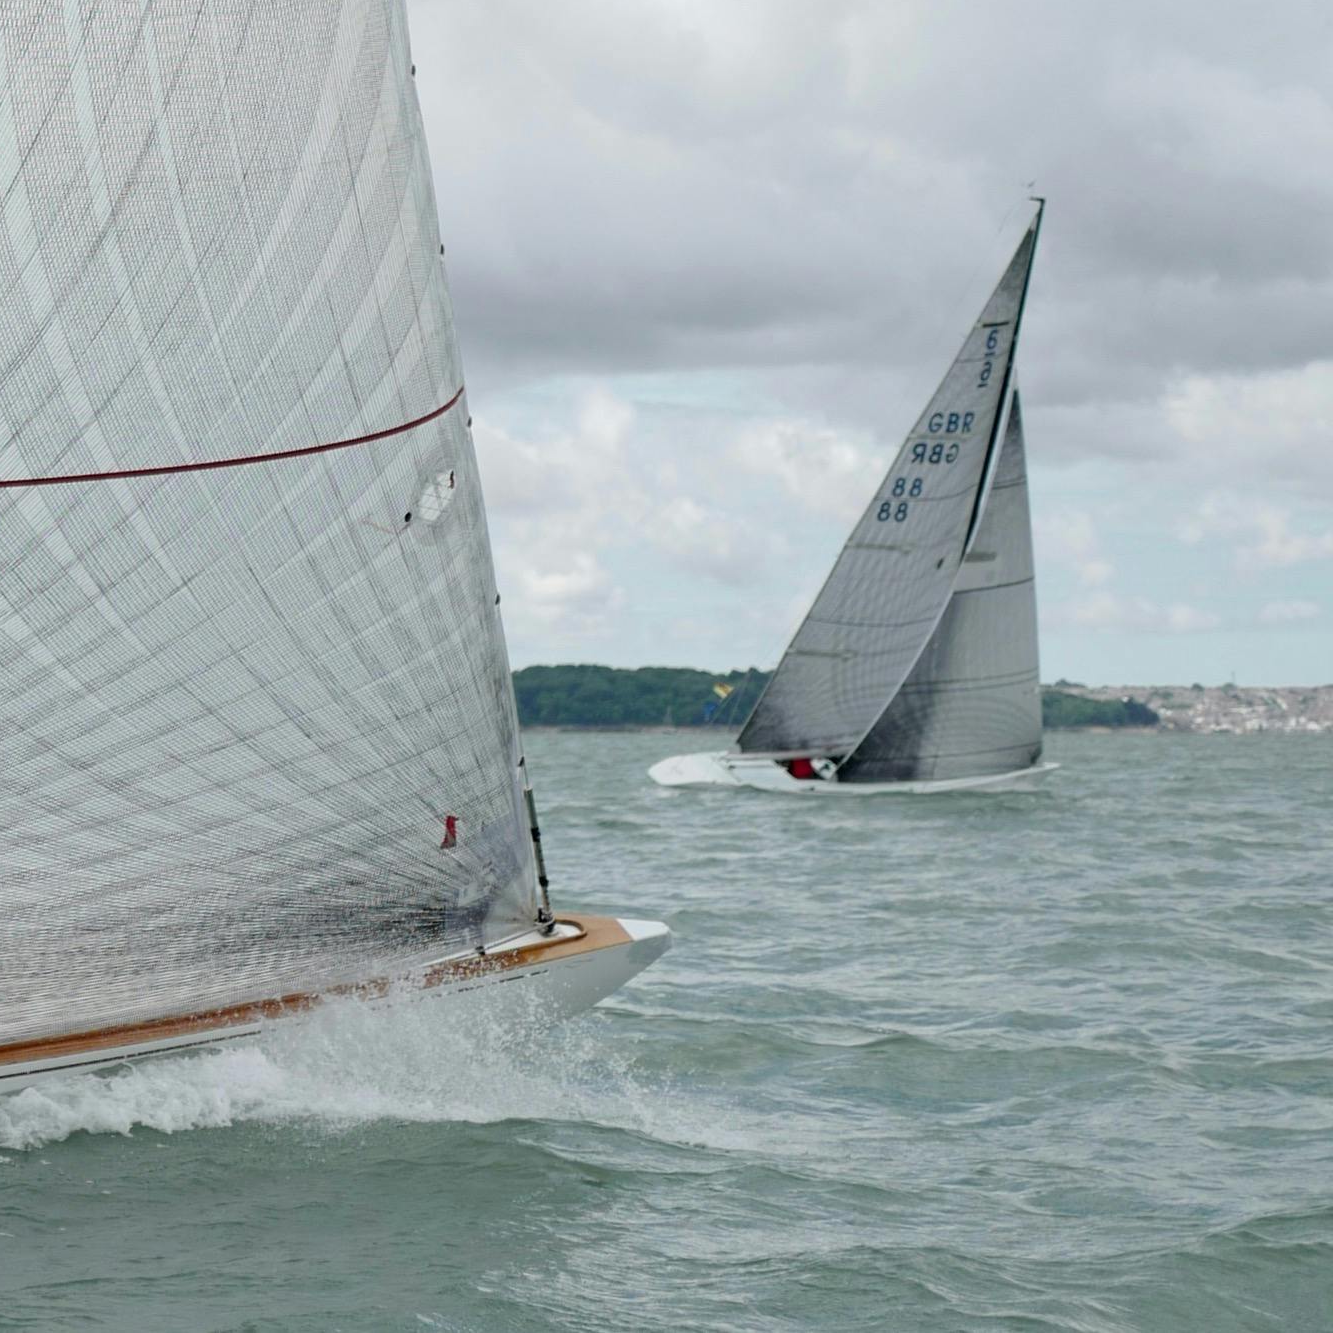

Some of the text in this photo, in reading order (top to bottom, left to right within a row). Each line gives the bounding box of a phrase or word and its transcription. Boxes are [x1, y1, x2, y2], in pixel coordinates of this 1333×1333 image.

[987, 329, 998, 349] 6
[929, 413, 974, 433] GBR
[892, 477, 923, 498] 88
